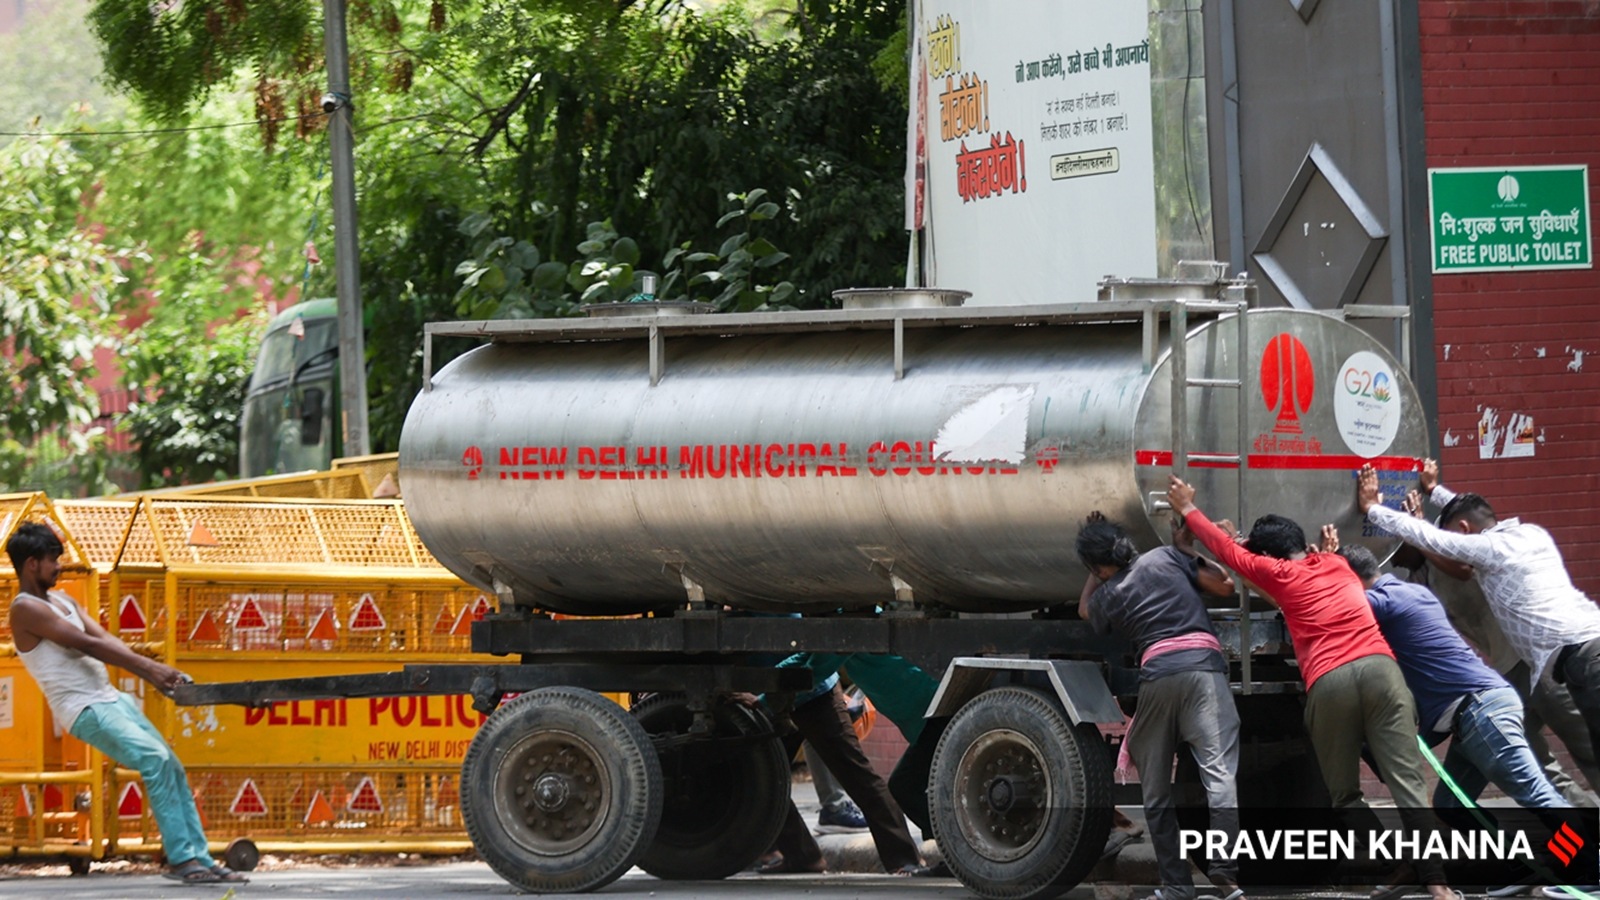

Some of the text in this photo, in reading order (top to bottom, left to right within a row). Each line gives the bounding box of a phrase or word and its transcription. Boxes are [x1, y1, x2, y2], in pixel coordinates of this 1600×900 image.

[1026, 61, 1040, 81] आप
[1102, 43, 1112, 69] भी
[1115, 39, 1149, 67] अपनायें
[1500, 215, 1524, 234] जन
[1441, 241, 1582, 264] FREE PUBLIC TOILET
[499, 447, 568, 480] NEW
[577, 445, 669, 480] DELHI
[679, 442, 858, 478] MUNICIPAL
[368, 741, 400, 760] NEW
[406, 741, 440, 759] DELHI
